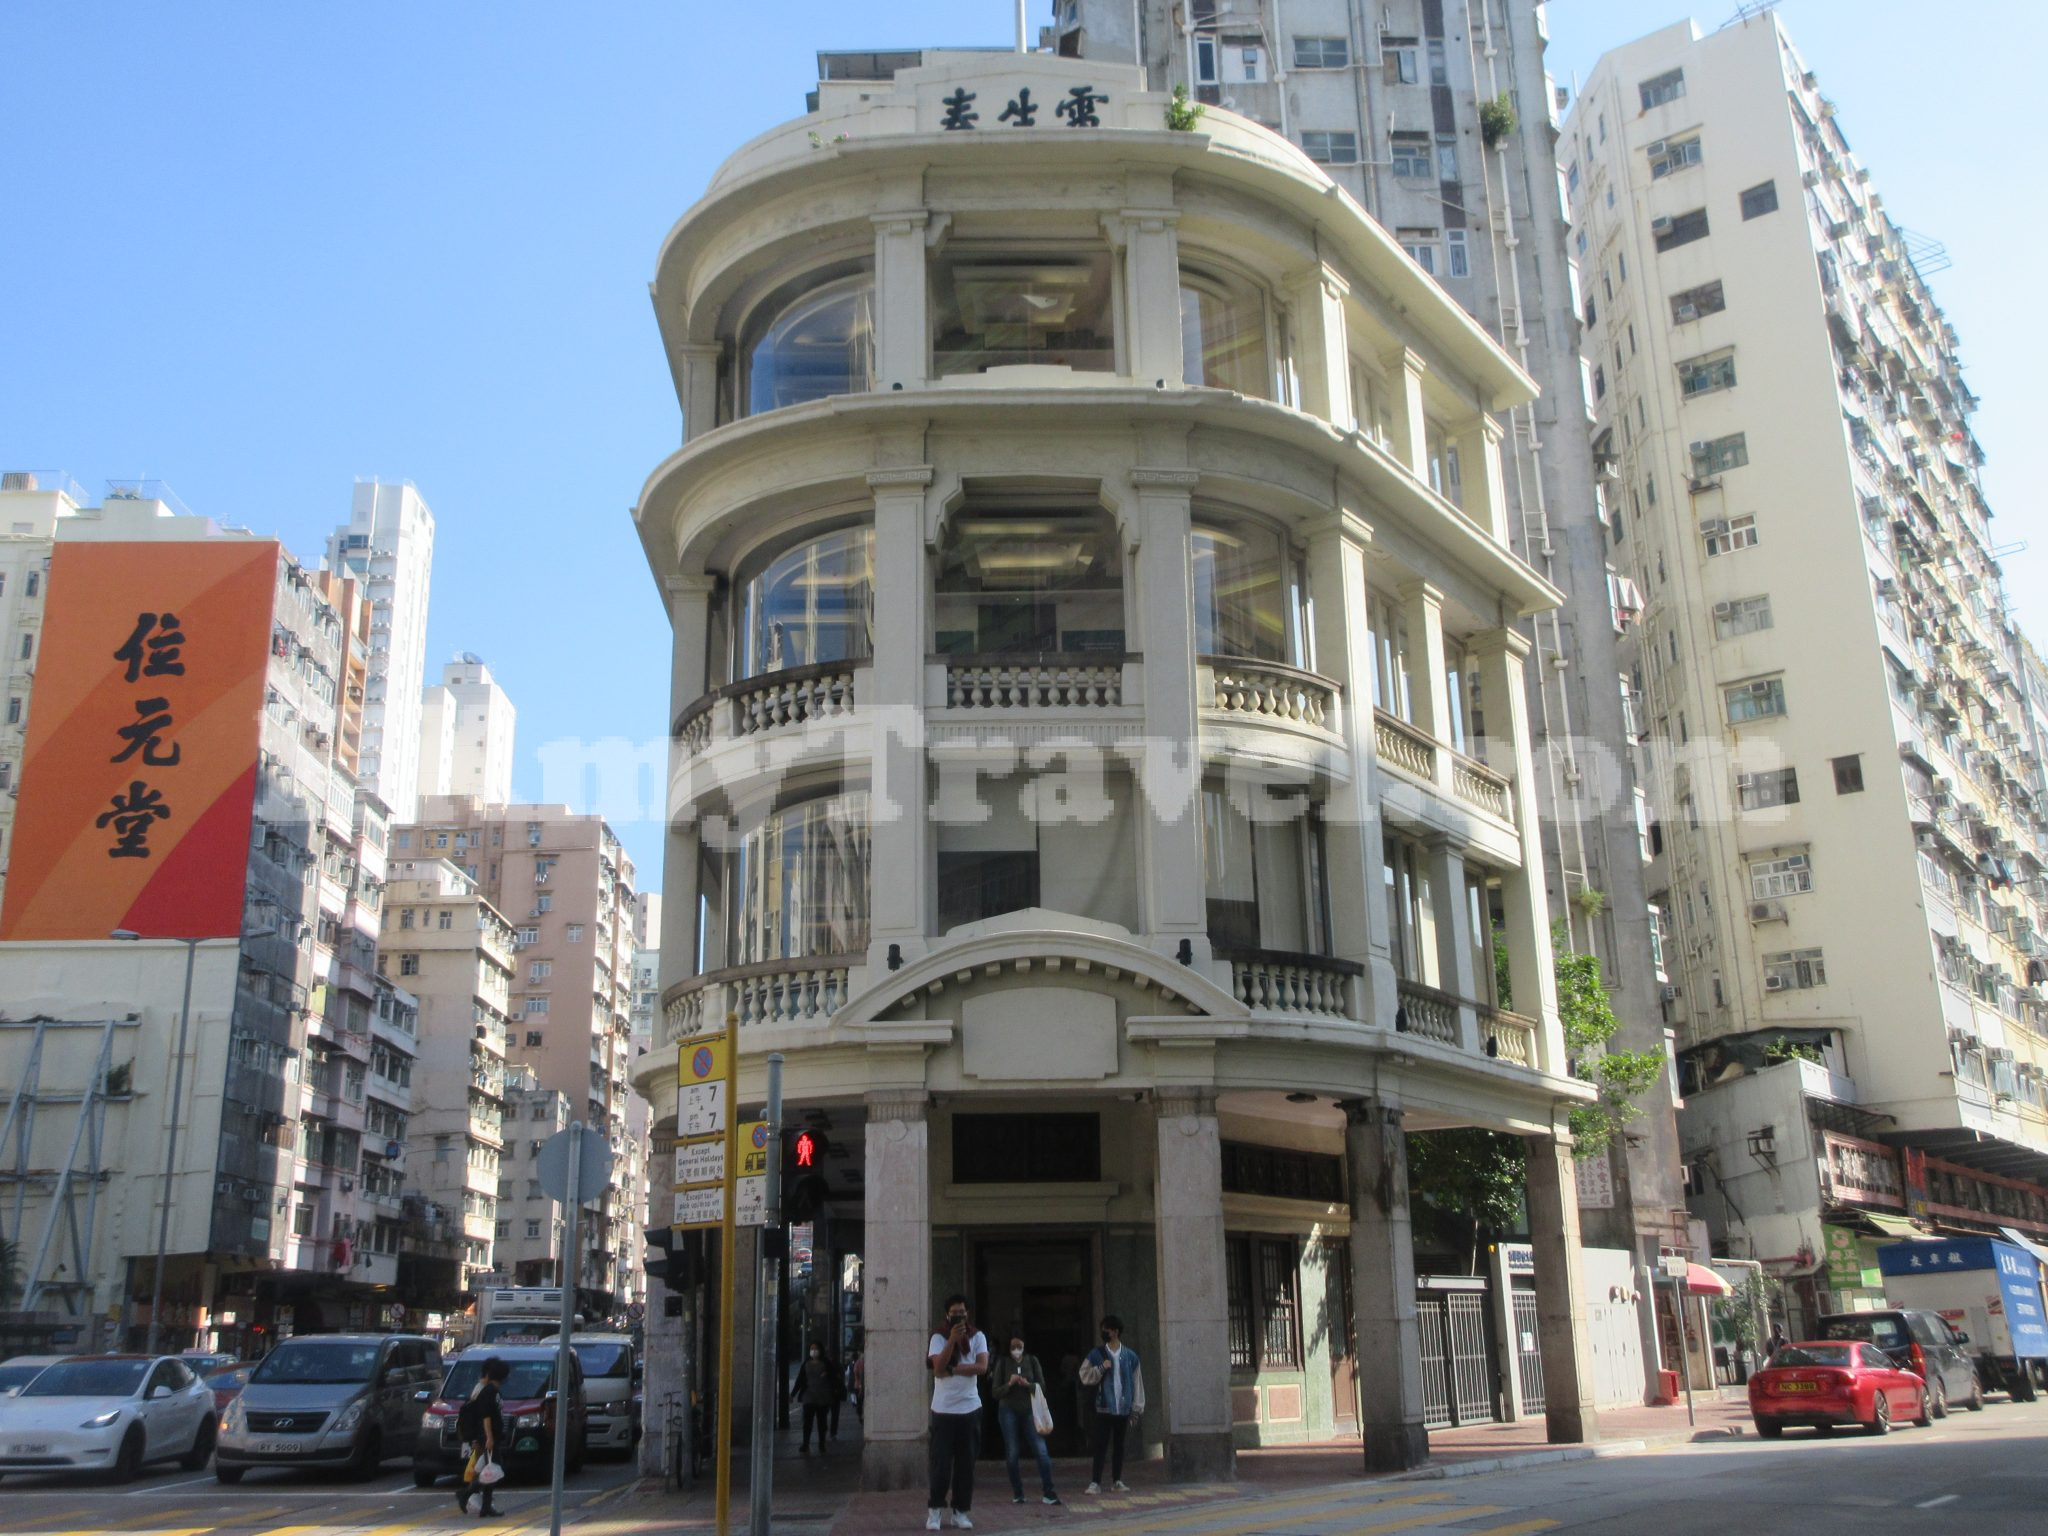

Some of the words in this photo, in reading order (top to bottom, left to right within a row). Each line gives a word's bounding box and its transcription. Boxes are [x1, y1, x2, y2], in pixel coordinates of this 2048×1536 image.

[96, 612, 187, 859] 位元堂
[688, 1094, 702, 1105] 上午
[708, 1085, 717, 1102] 7
[708, 1112, 717, 1128] 7
[691, 1146, 710, 1156] Except
[678, 1156, 699, 1166] General
[700, 1154, 724, 1164] Holidays
[738, 1204, 761, 1213] midnight
